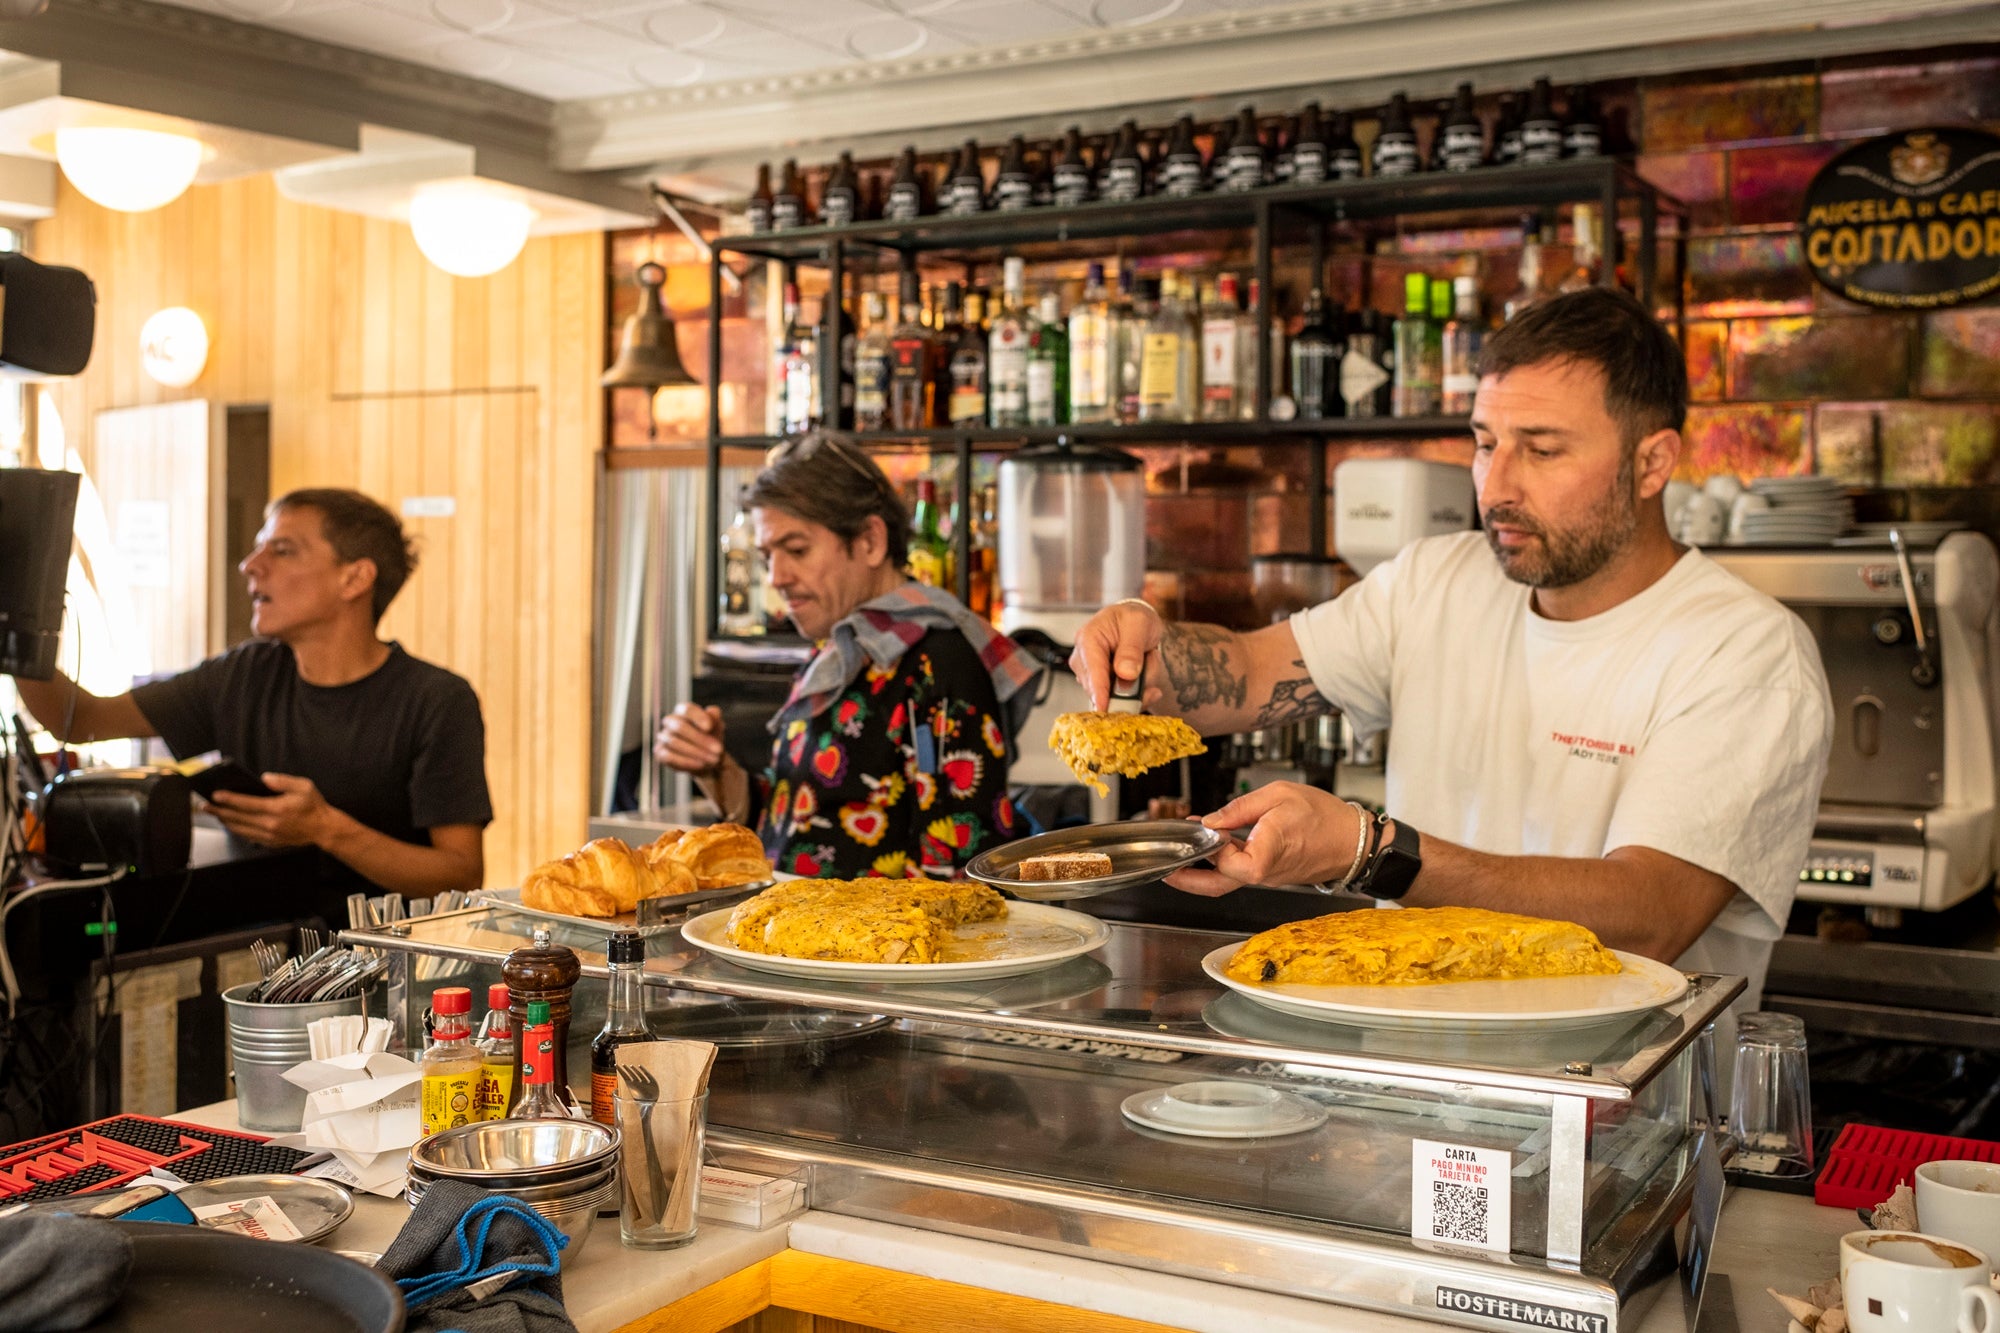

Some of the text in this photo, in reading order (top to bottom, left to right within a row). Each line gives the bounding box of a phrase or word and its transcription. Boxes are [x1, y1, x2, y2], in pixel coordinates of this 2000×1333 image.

[1445, 1148, 1477, 1162] CARTA
[1431, 1159, 1487, 1175] PAGO MINIMO
[1439, 1169, 1471, 1182] TARJETA
[1437, 1289, 1605, 1333] HOSTELMARKT
